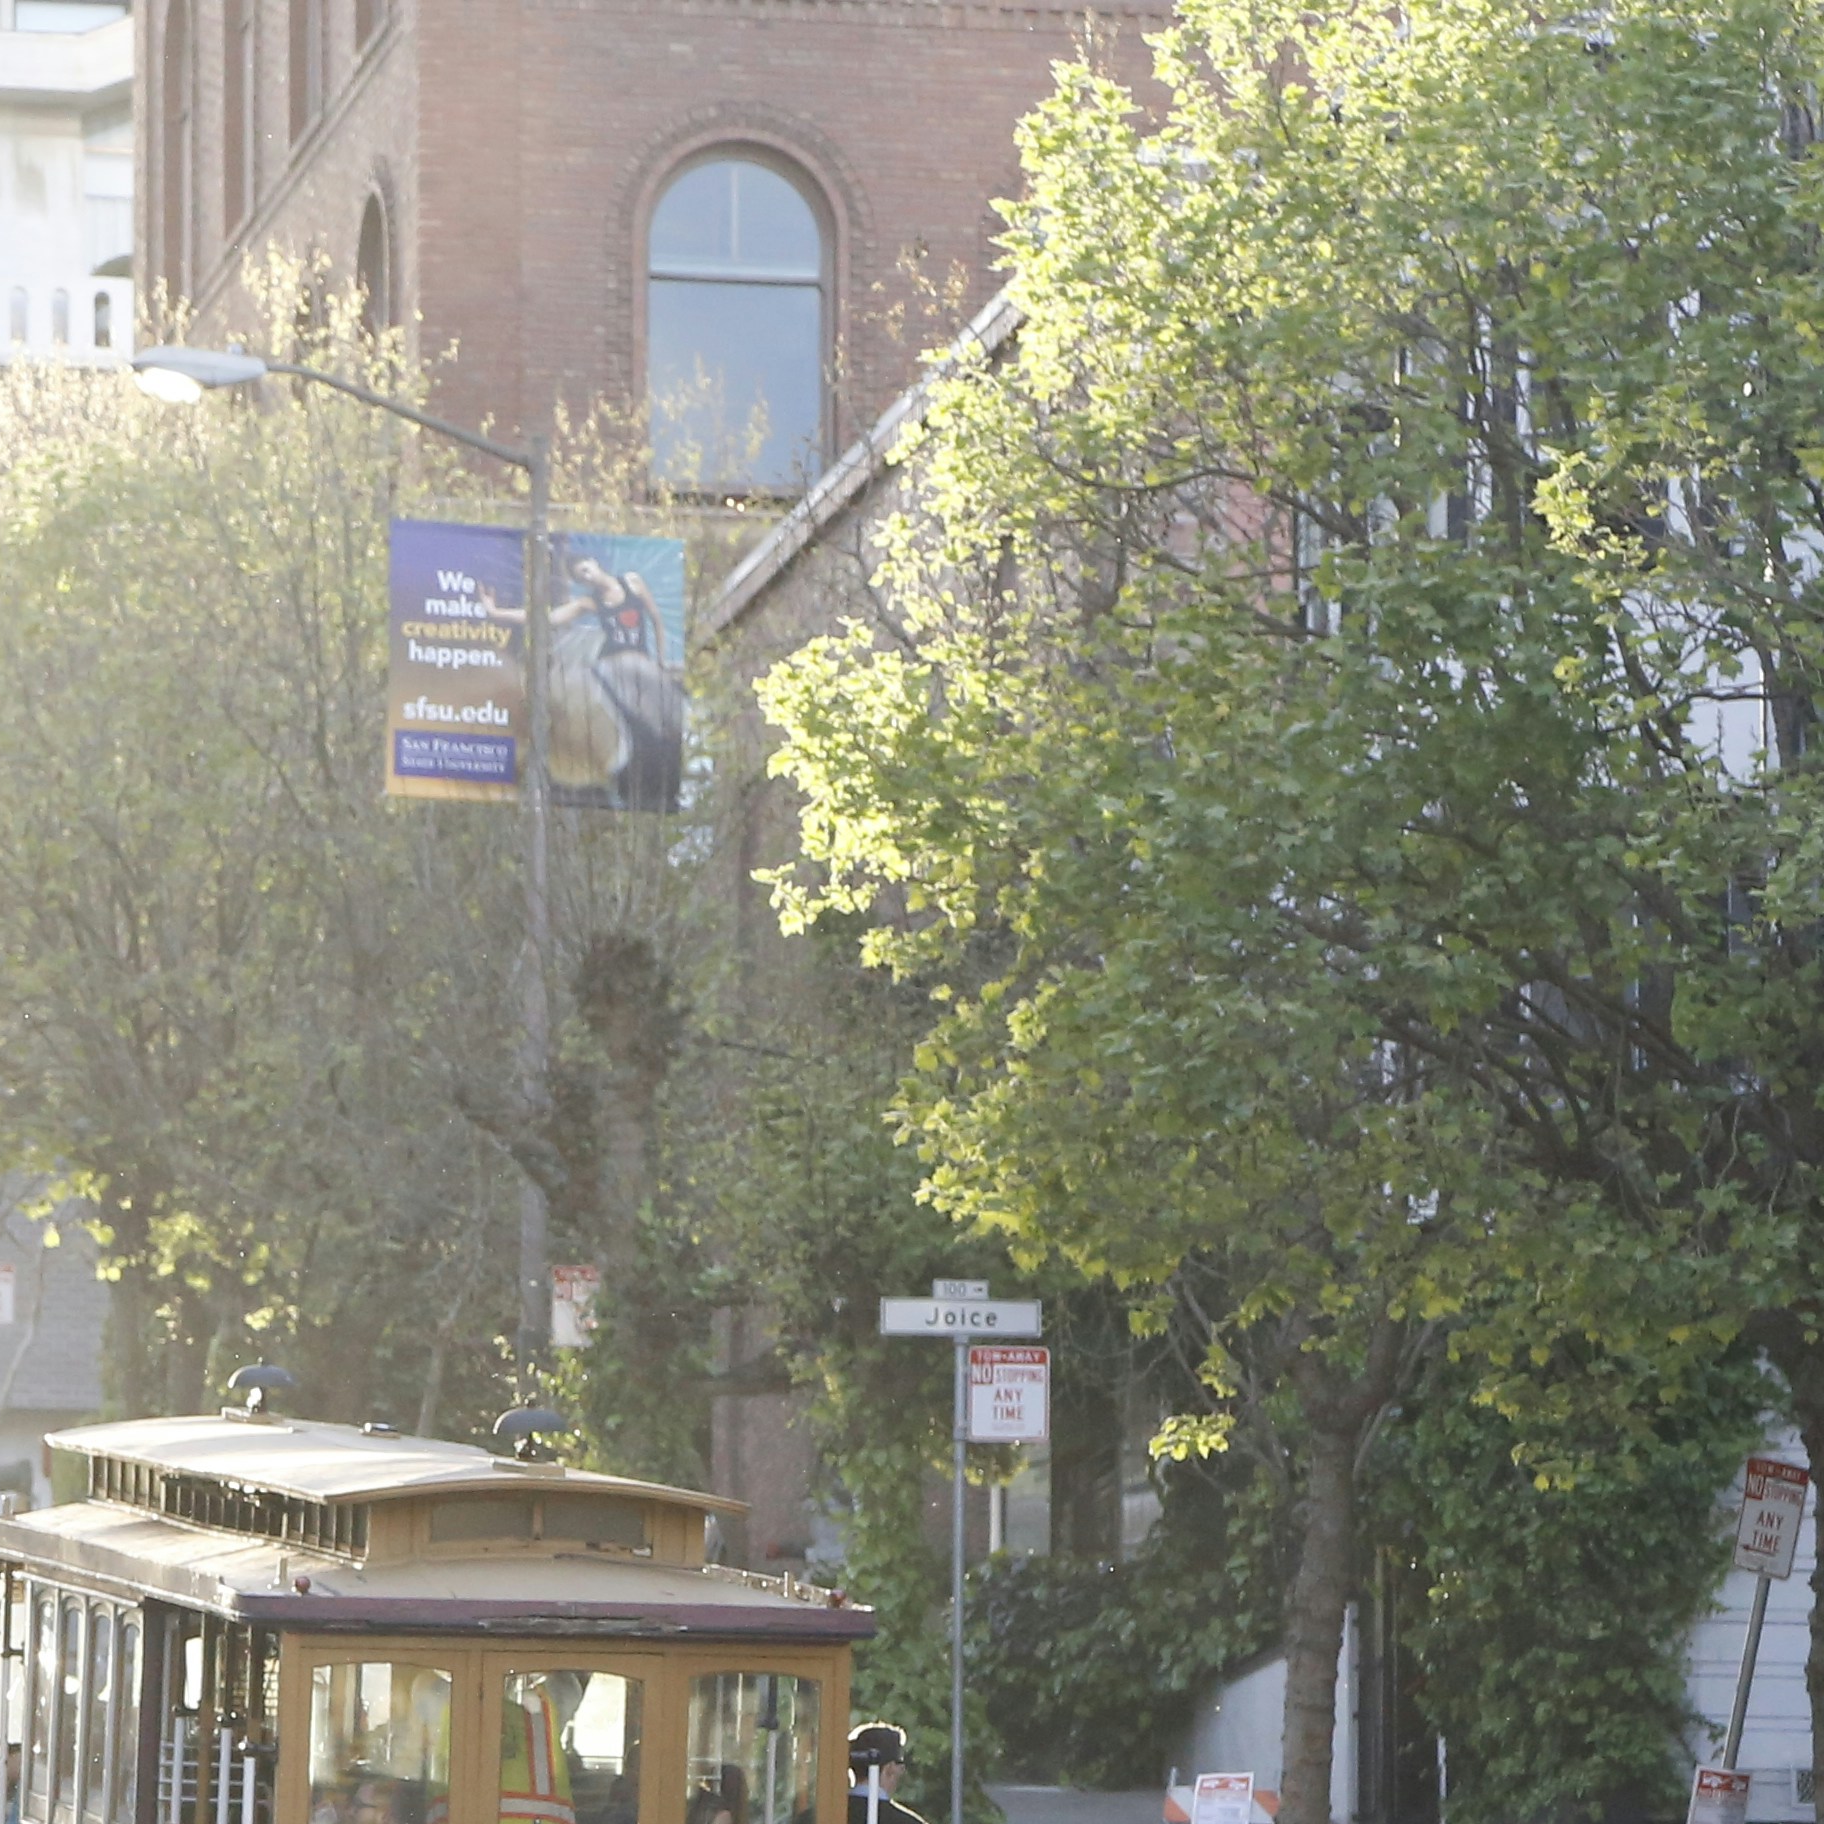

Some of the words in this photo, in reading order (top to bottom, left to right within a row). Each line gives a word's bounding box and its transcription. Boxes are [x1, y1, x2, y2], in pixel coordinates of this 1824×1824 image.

[437, 569, 475, 593] We
[426, 595, 487, 618] make
[401, 621, 512, 647] creativity
[408, 640, 503, 669] happen.
[403, 697, 509, 725] sfsu.edu
[925, 1306, 998, 1327] Joice
[972, 1364, 992, 1383] NO
[993, 1388, 1023, 1402] ANY
[993, 1405, 1023, 1420] TIME
[1747, 1473, 1763, 1497] NO
[1756, 1510, 1784, 1530] ANY
[1753, 1529, 1781, 1552] TIME
